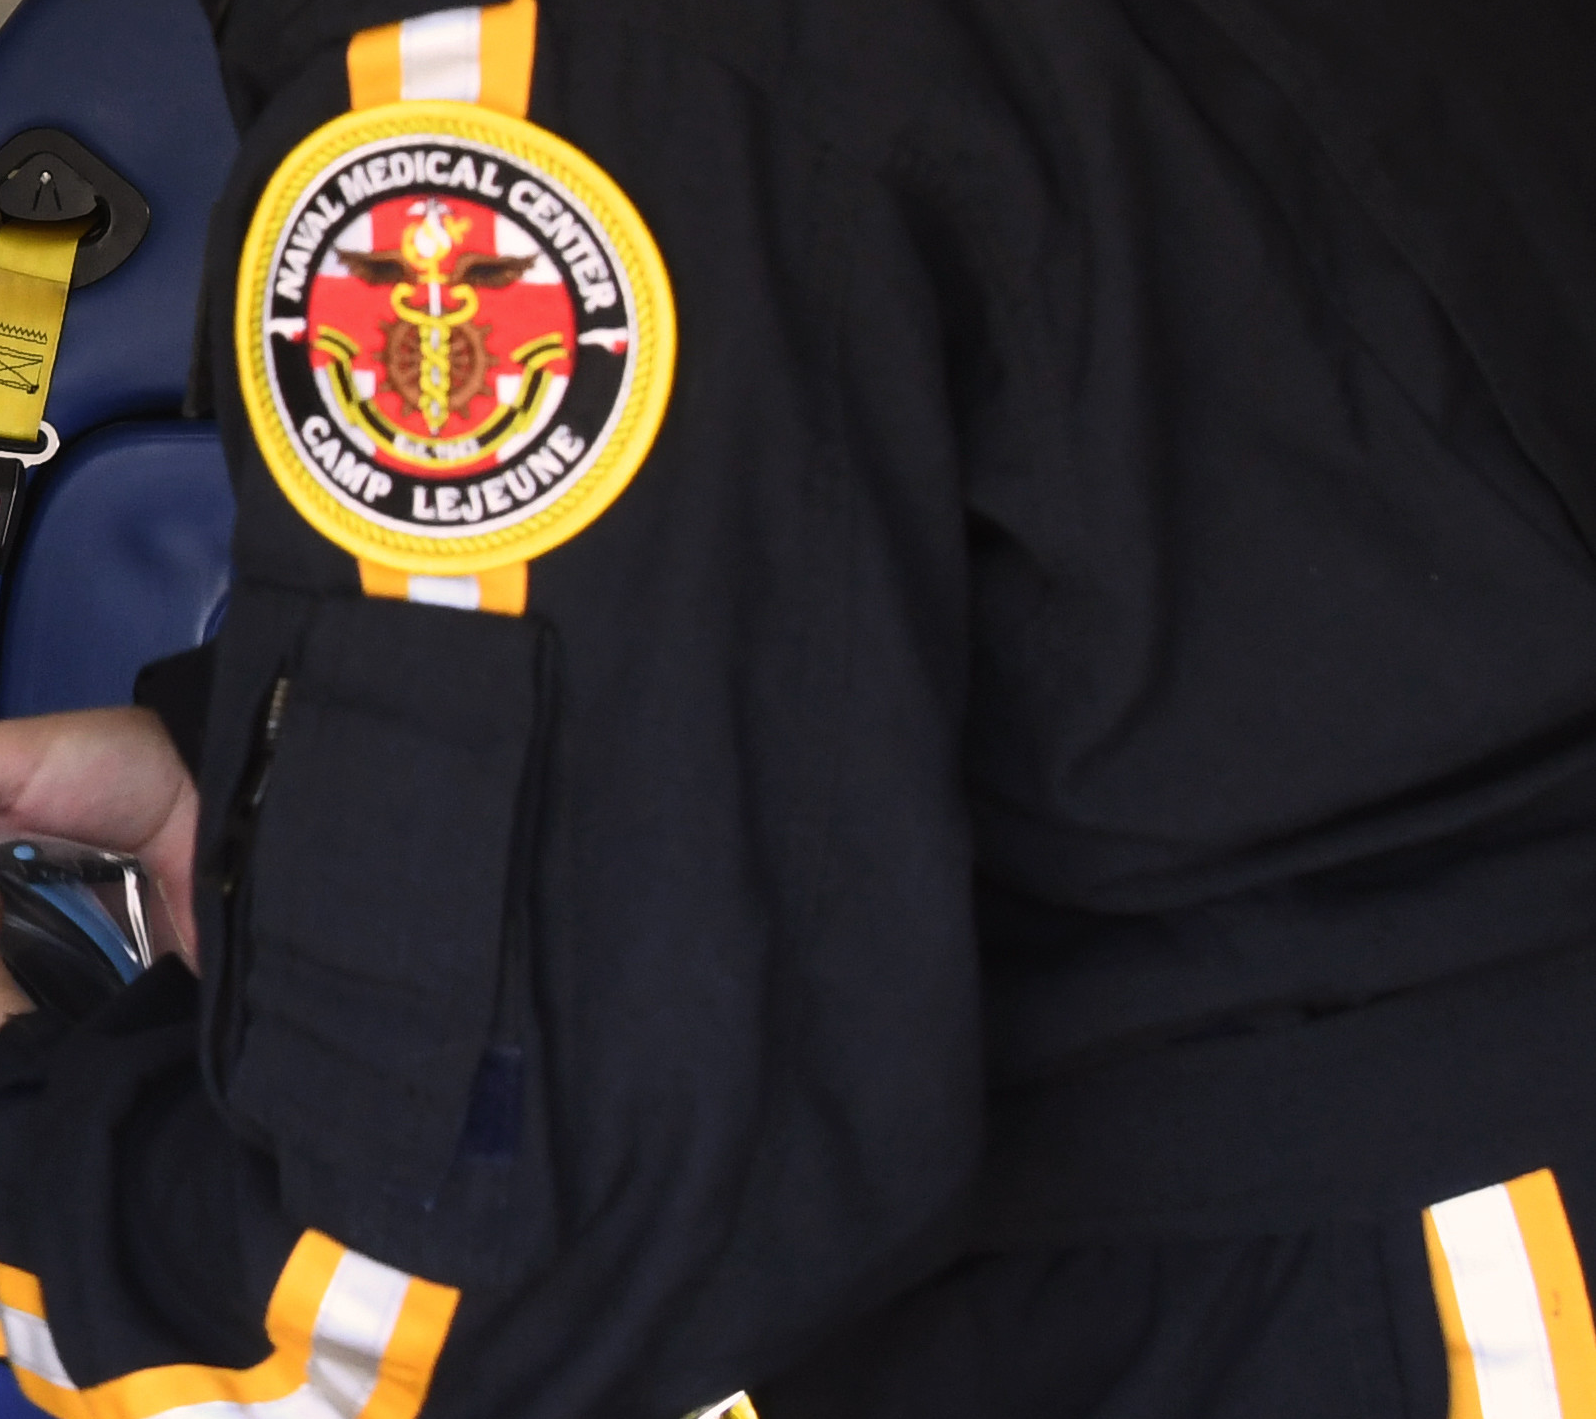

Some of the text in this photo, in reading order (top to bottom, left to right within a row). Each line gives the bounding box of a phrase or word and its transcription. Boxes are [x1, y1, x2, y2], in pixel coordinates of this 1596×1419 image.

[277, 150, 613, 315] NAVAL MEDICAL CENTER
[299, 413, 585, 523] CAMP LEJEUNE
